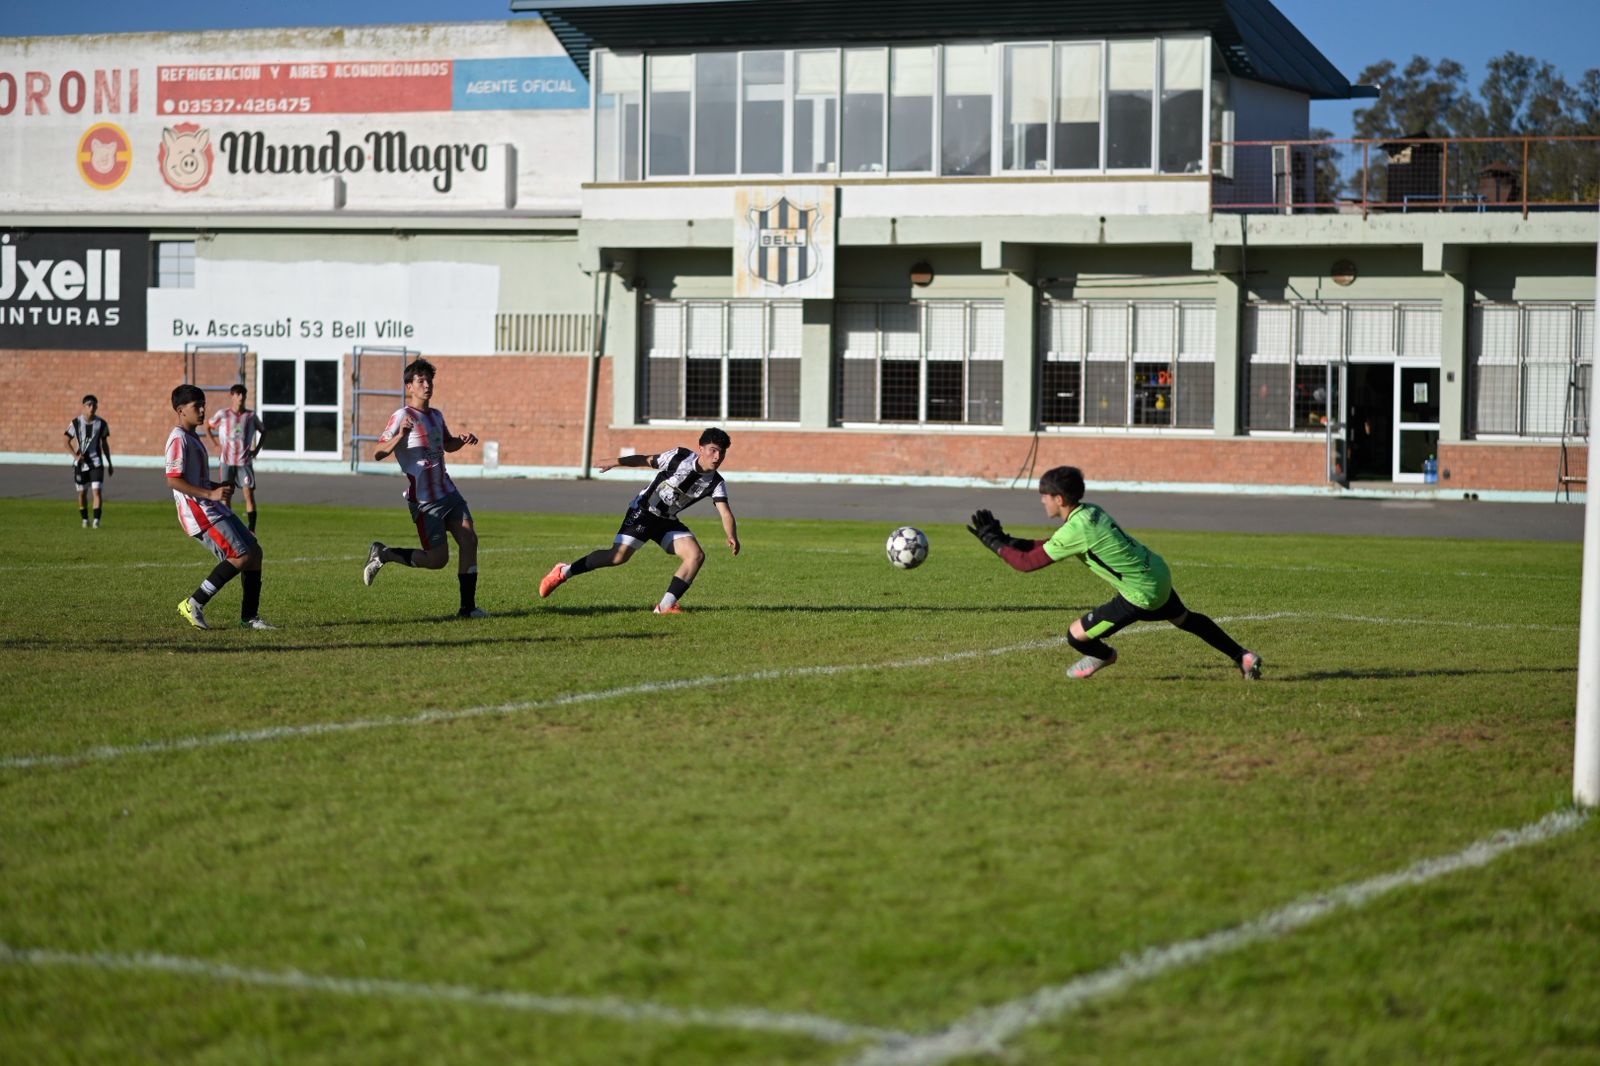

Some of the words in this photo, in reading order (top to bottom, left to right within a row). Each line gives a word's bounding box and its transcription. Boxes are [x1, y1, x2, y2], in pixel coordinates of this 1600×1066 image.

[161, 65, 261, 82] REFRIGERACION
[270, 65, 280, 80] Y
[289, 64, 328, 79] AIRES
[334, 62, 449, 78] ACONDICIONADOS
[466, 80, 518, 94] AGENTE
[522, 79, 576, 93] OFICIAL
[762, 235, 804, 245] BELL
[173, 319, 199, 336] Bv.
[206, 318, 292, 337] Ascasubi
[300, 320, 324, 338] 53
[332, 320, 366, 338] Bell
[374, 319, 414, 338] Ville
